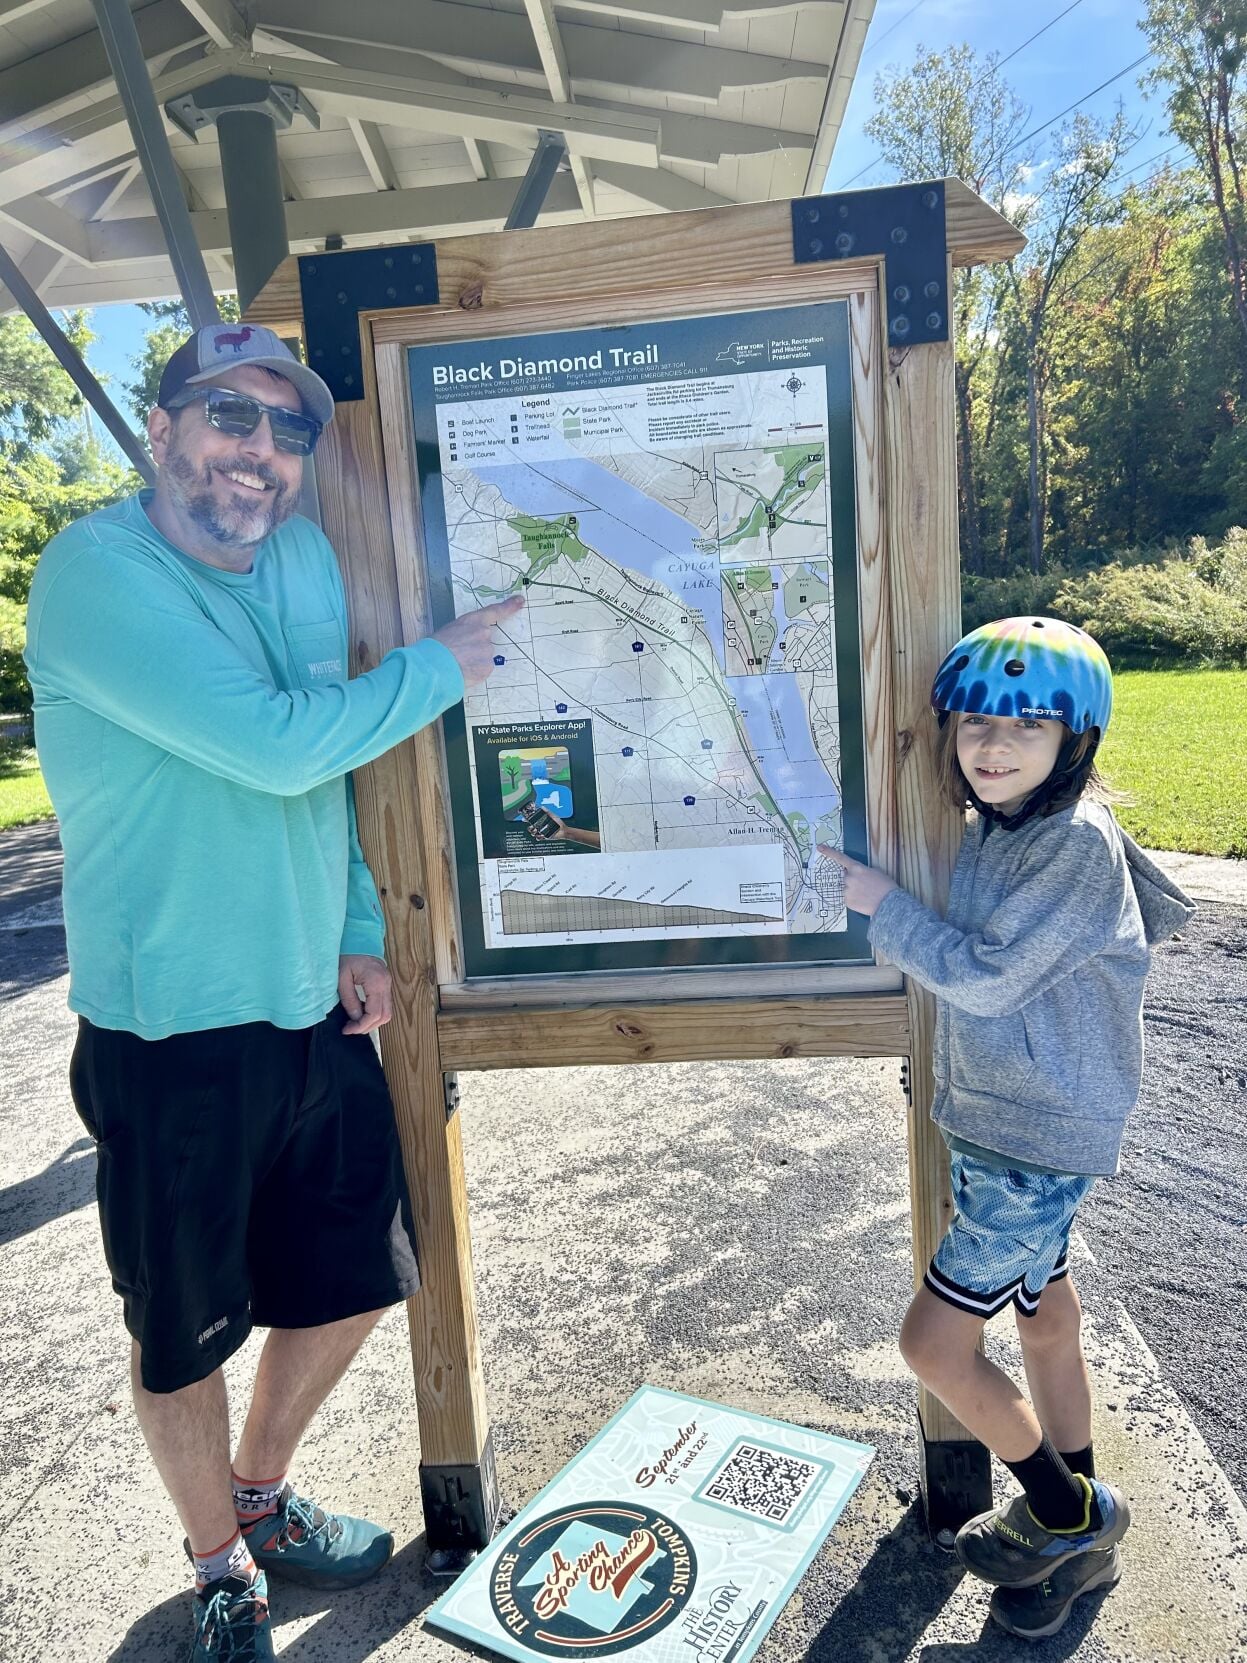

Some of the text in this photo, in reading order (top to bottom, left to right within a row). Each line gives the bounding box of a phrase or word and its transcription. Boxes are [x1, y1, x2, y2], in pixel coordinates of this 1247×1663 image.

[792, 336, 824, 345] Recreation
[772, 352, 811, 360] Preservation
[432, 344, 658, 385] Black Diamond Trail
[566, 372, 584, 380] Finger
[585, 370, 602, 378] Lakes
[603, 368, 626, 376] Regional
[644, 364, 660, 372] (607)
[598, 376, 614, 384] (607)
[640, 370, 682, 380] EMERGENCIES
[522, 399, 550, 408] Legend
[598, 404, 622, 412] Diamond
[524, 412, 545, 420] Parking
[523, 532, 569, 542] Taughannock
[668, 562, 714, 573] CAYUGA
[682, 580, 714, 590] LAKE
[597, 588, 676, 637] Black Diamond Trail
[1022, 708, 1063, 716] PRO-TEC
[478, 721, 585, 735] NY State Parks Explorer App!
[487, 736, 518, 744] Available
[520, 734, 528, 742] for
[530, 734, 542, 742] iOS
[551, 732, 578, 740] Android
[728, 827, 746, 835] Allan
[816, 873, 831, 881] City
[635, 1420, 696, 1488] September
[680, 1450, 698, 1468] and
[693, 1432, 709, 1450] 22nd
[993, 1516, 1034, 1548] MERRELL
[590, 1530, 645, 1592] Chance
[650, 1518, 690, 1595] TOMPKINS
[546, 1551, 570, 1585] A
[535, 1541, 610, 1619] Sporting
[495, 1552, 530, 1636] TRAVERSE
[682, 1608, 704, 1629] THE
[683, 1580, 742, 1651] HISTORY
[739, 1619, 756, 1644] Tompkins
[752, 1602, 767, 1618] County
[696, 1607, 751, 1663] CENTER
